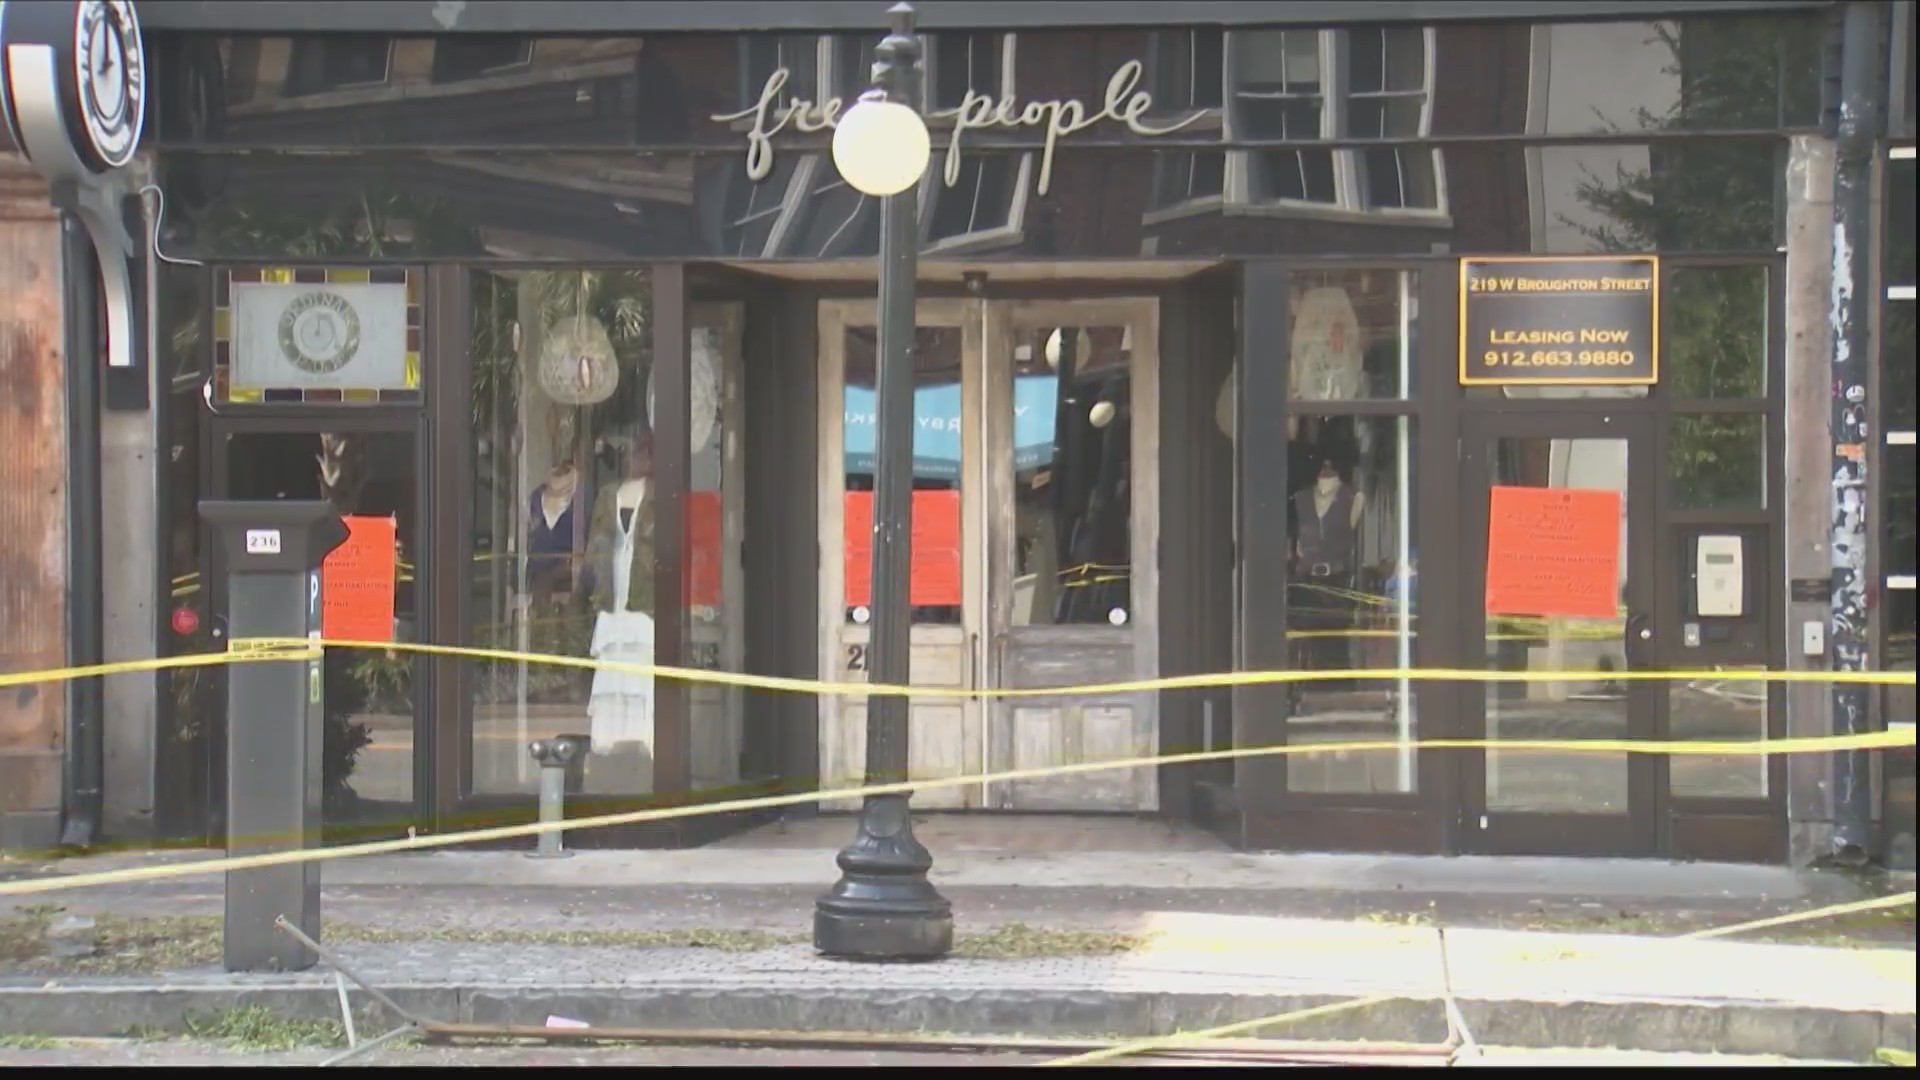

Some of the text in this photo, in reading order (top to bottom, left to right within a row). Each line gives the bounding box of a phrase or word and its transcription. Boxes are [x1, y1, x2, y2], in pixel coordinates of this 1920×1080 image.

[711, 60, 1208, 196] fre people
[1470, 276, 1650, 291] 219 W BROUGHTON STREET
[1490, 329, 1630, 344] LEASING NOW
[1484, 351, 1634, 366] 912.663.9880
[310, 574, 319, 615] P
